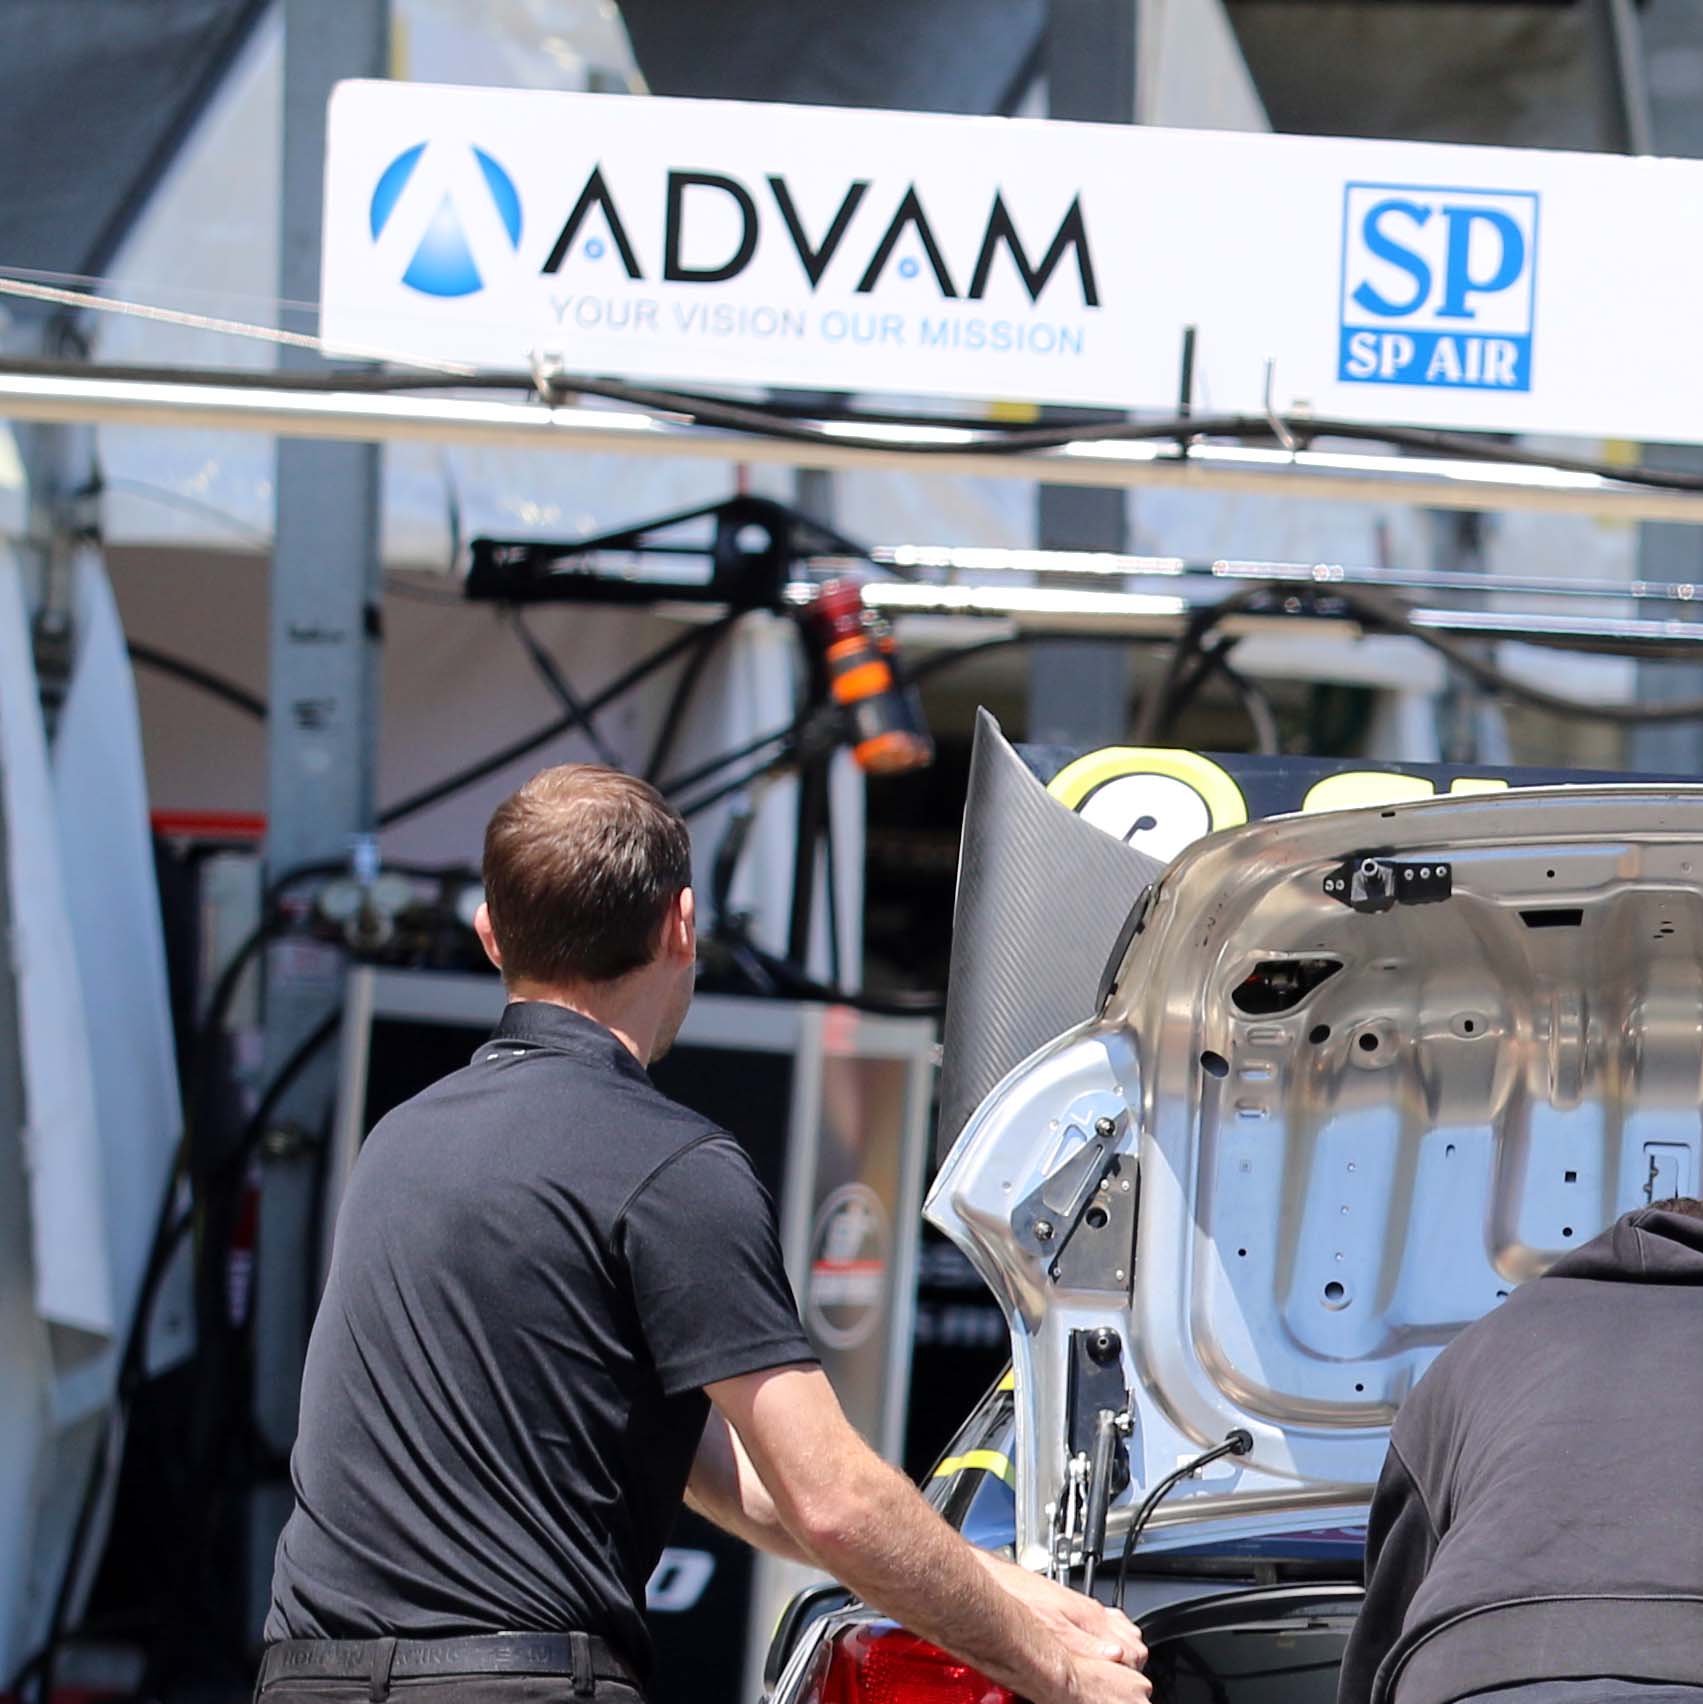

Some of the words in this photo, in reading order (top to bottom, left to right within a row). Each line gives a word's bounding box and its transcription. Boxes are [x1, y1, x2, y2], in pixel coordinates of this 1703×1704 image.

[541, 163, 1102, 309] ADVAM
[1350, 196, 1526, 322] SP
[550, 294, 660, 334] YOUR
[672, 300, 806, 342] VISION
[818, 311, 906, 346] OUR
[918, 316, 1086, 356] MISSION
[1346, 331, 1420, 382] SP
[1428, 336, 1518, 387] AIR
